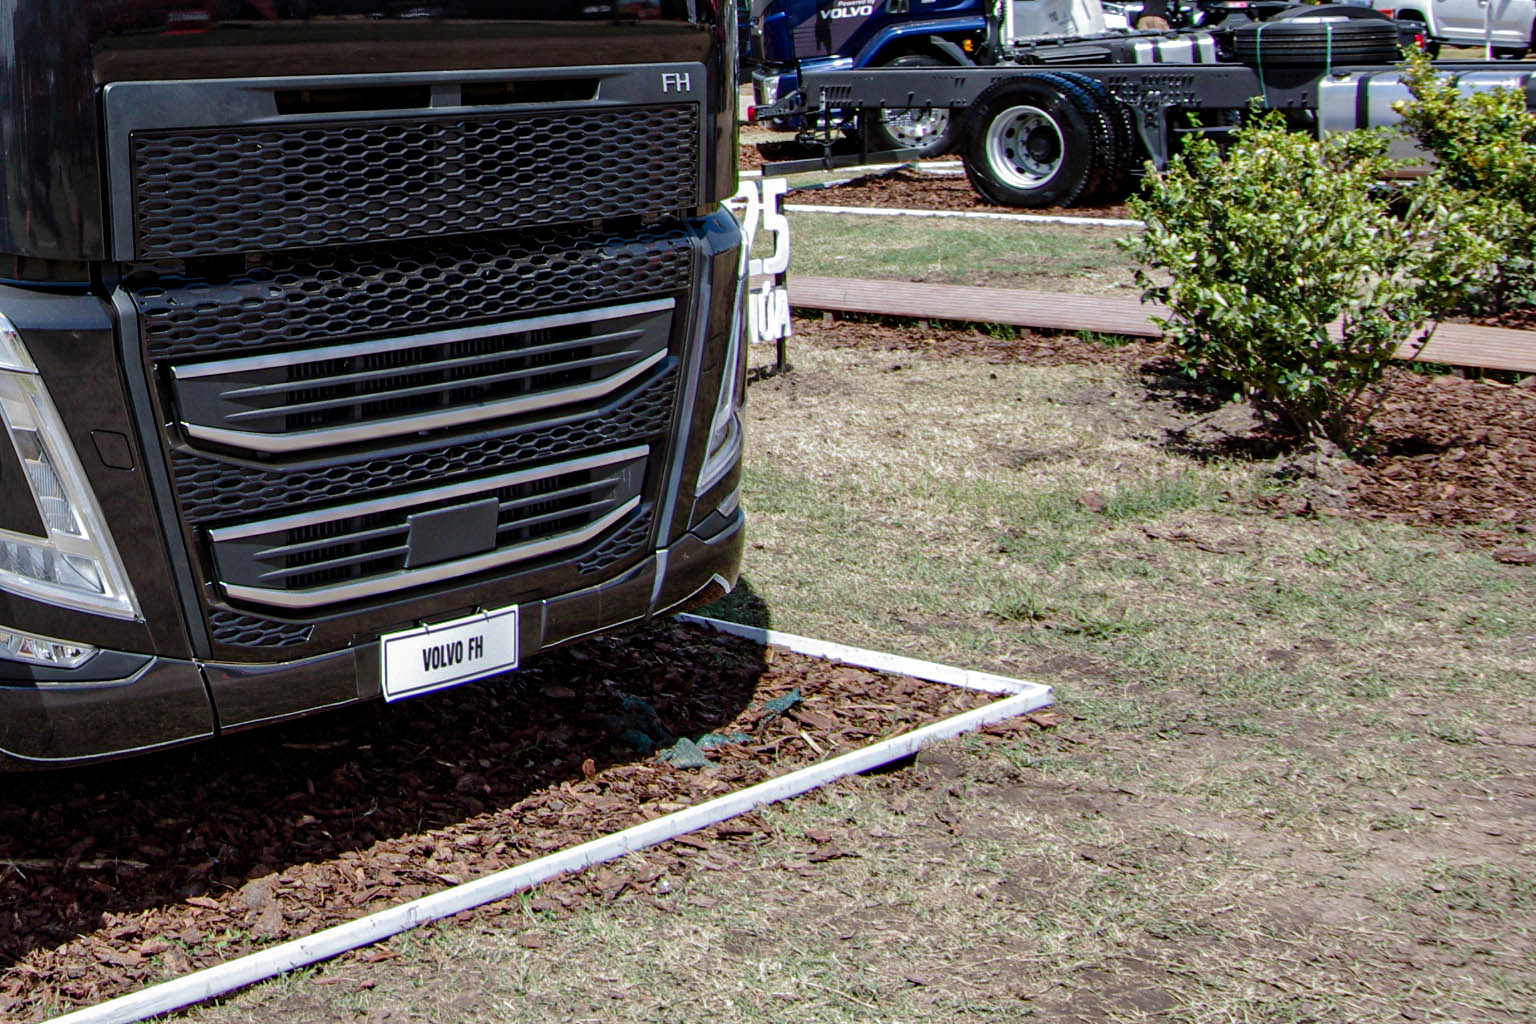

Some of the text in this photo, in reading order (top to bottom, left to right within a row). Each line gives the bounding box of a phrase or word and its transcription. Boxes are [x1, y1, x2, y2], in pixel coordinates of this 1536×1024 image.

[820, 5, 873, 20] VOLVO
[661, 72, 691, 93] FH
[422, 634, 484, 672] VOLVO FH
